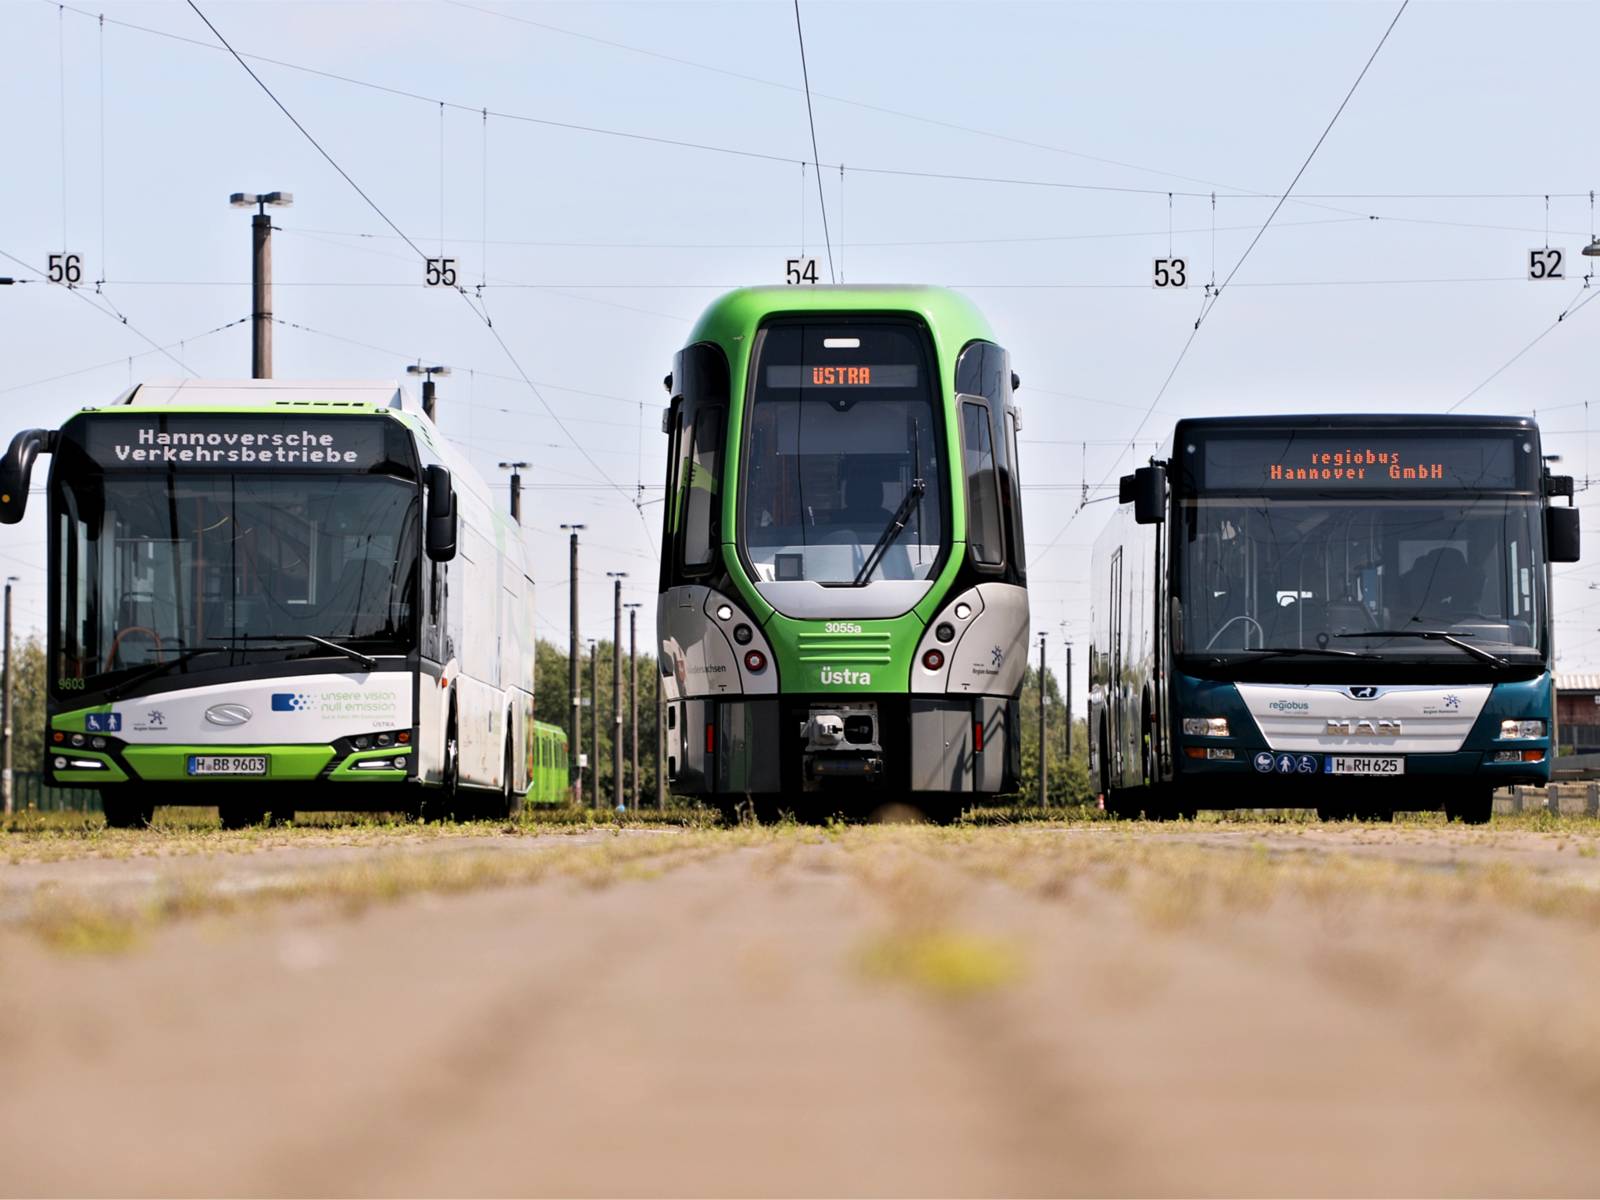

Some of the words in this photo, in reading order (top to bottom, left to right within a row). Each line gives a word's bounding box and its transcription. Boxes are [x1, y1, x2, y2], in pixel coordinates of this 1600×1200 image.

[49, 255, 81, 283] 56
[426, 259, 456, 286] 55
[786, 259, 819, 285] 54
[1154, 259, 1186, 287] 53
[1530, 250, 1562, 279] 52
[812, 366, 871, 385] ÜSTRA
[138, 428, 334, 447] Hannoversche
[114, 445, 358, 463] Verkehrsbetriebe
[1311, 449, 1400, 466] regiobus
[1270, 464, 1366, 480] Hannover
[1388, 464, 1443, 480] GmbH
[825, 622, 862, 633] 3055a
[820, 666, 871, 685] üstra
[58, 679, 86, 690] 9603
[320, 691, 361, 701] unsere
[320, 702, 342, 712] null
[345, 702, 396, 712] emission
[1269, 700, 1309, 711] regiobus
[1327, 719, 1402, 736] MAN
[196, 758, 205, 771] H
[213, 758, 230, 771] BB
[233, 758, 265, 771] 9603
[1336, 758, 1345, 772] H
[1353, 758, 1371, 772] RH
[1373, 759, 1398, 772] 625
